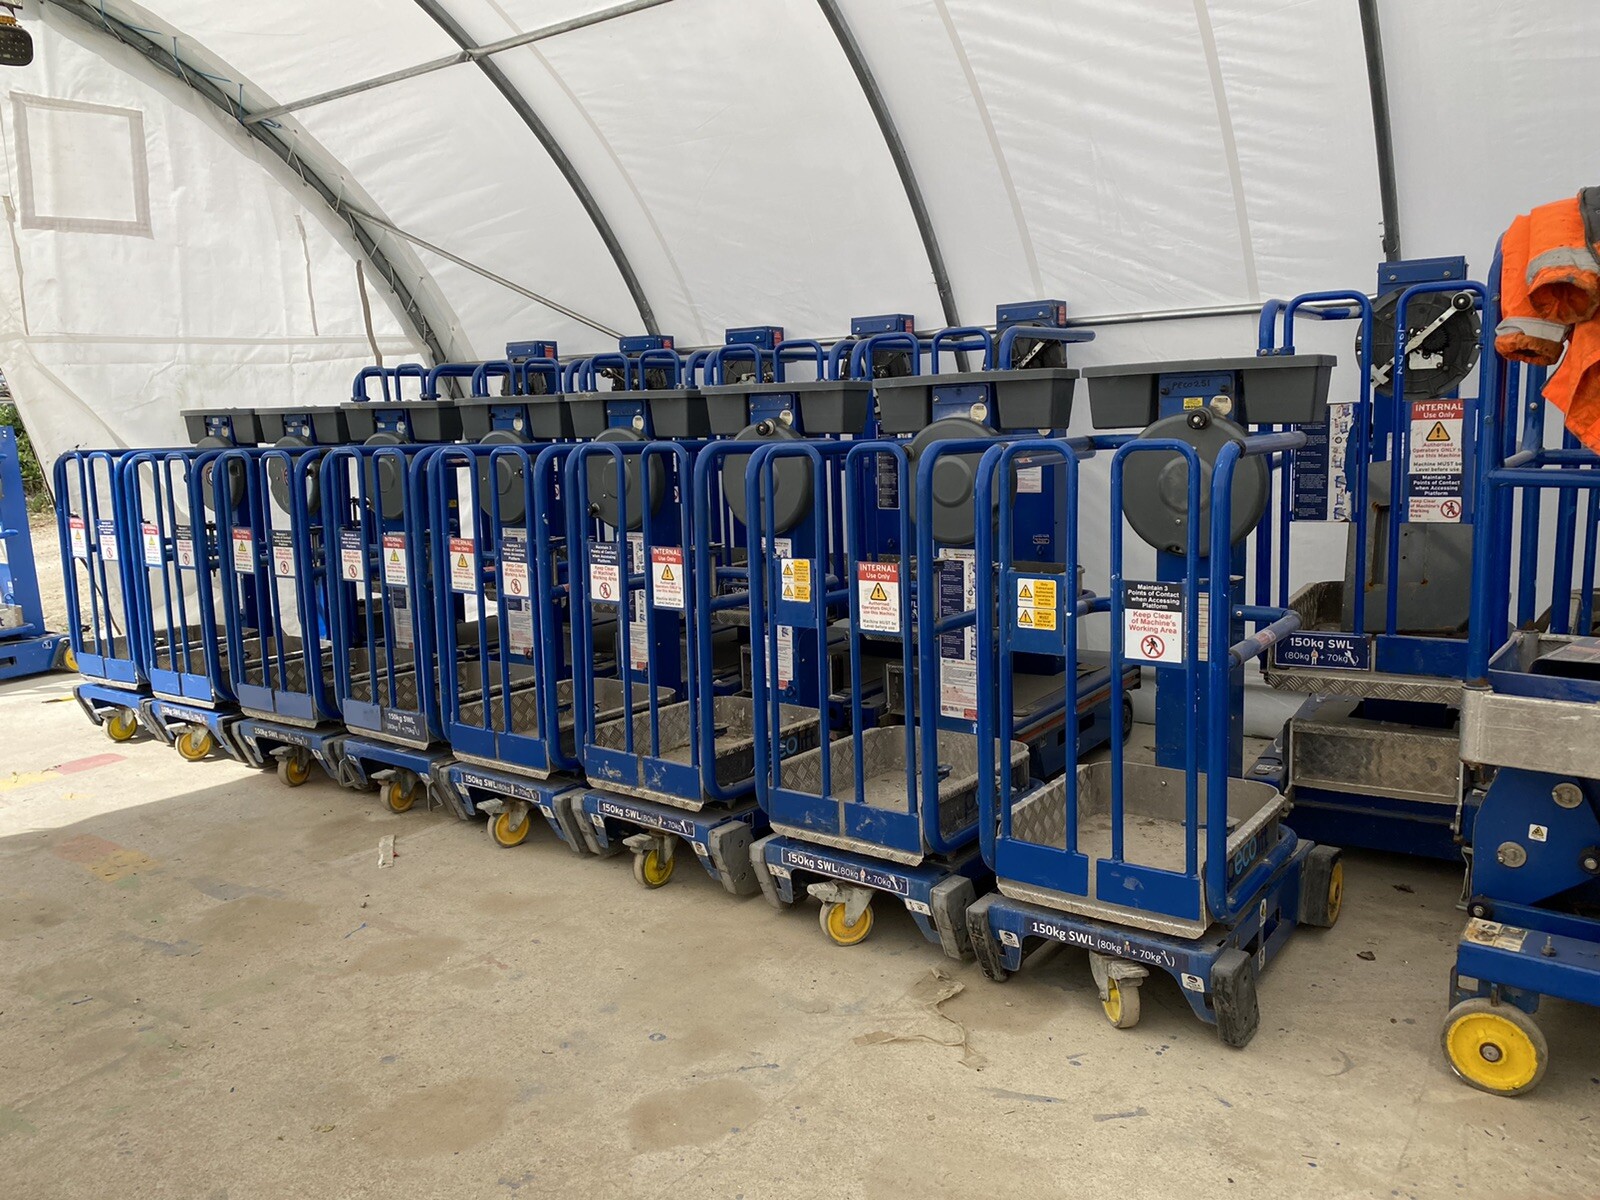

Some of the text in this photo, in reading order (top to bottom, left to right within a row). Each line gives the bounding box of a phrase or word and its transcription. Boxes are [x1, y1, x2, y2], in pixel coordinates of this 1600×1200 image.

[1415, 403, 1463, 412] INTERNAL
[653, 548, 681, 556] INTERNAL
[859, 564, 896, 573] INTERNAL
[1148, 597, 1180, 606] Accessing
[1133, 611, 1173, 620] Keep Clear
[1141, 619, 1177, 627] Machine's
[1129, 625, 1177, 635] Working Area
[1290, 637, 1354, 650] 150kg SWL
[1284, 651, 1310, 661] (80kg
[1326, 653, 1348, 663] 70kg
[465, 775, 482, 787] 150kg
[484, 779, 498, 788] SWL
[602, 803, 624, 817] 150kg
[625, 808, 641, 820] SWL
[788, 853, 815, 868] 150kg
[817, 860, 838, 872] SWL
[837, 867, 859, 879] (80kg
[873, 874, 891, 888] 70kg
[1032, 922, 1066, 941] 150kg
[1069, 931, 1094, 946] SWL
[1097, 939, 1122, 955] (80kg
[1139, 949, 1162, 964] 70kg
